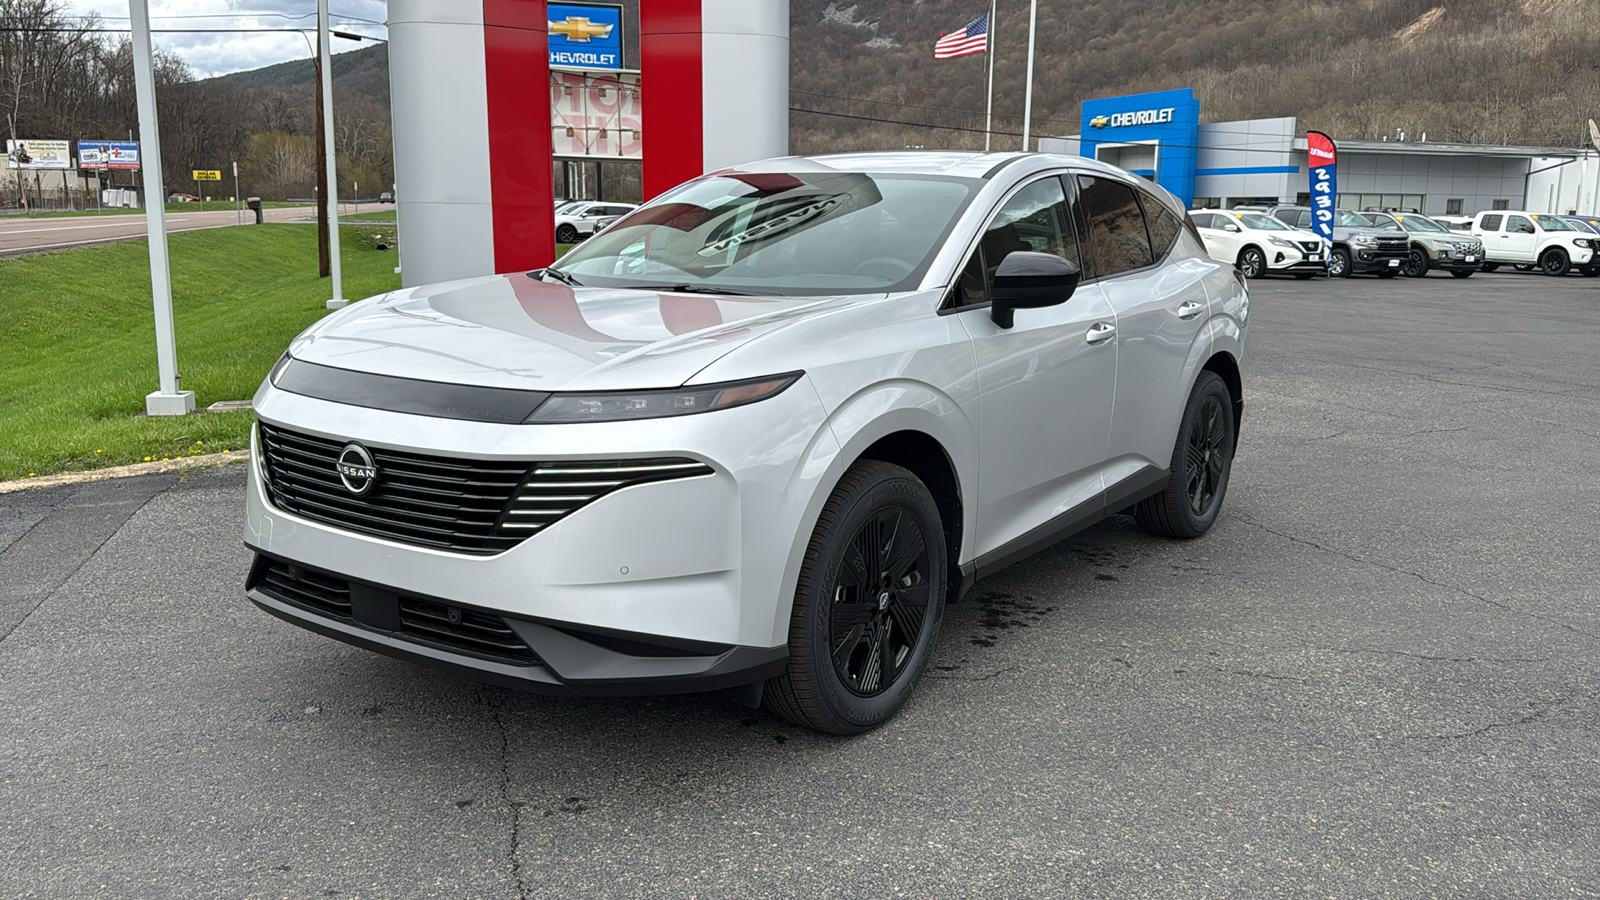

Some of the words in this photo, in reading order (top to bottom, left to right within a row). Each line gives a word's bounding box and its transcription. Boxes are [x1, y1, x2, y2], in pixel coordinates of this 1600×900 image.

[549, 52, 615, 64] HEVROLET
[1111, 108, 1175, 127] CHEVROLET
[444, 406, 516, 419] MURANO
[336, 463, 376, 478] NISSAN
